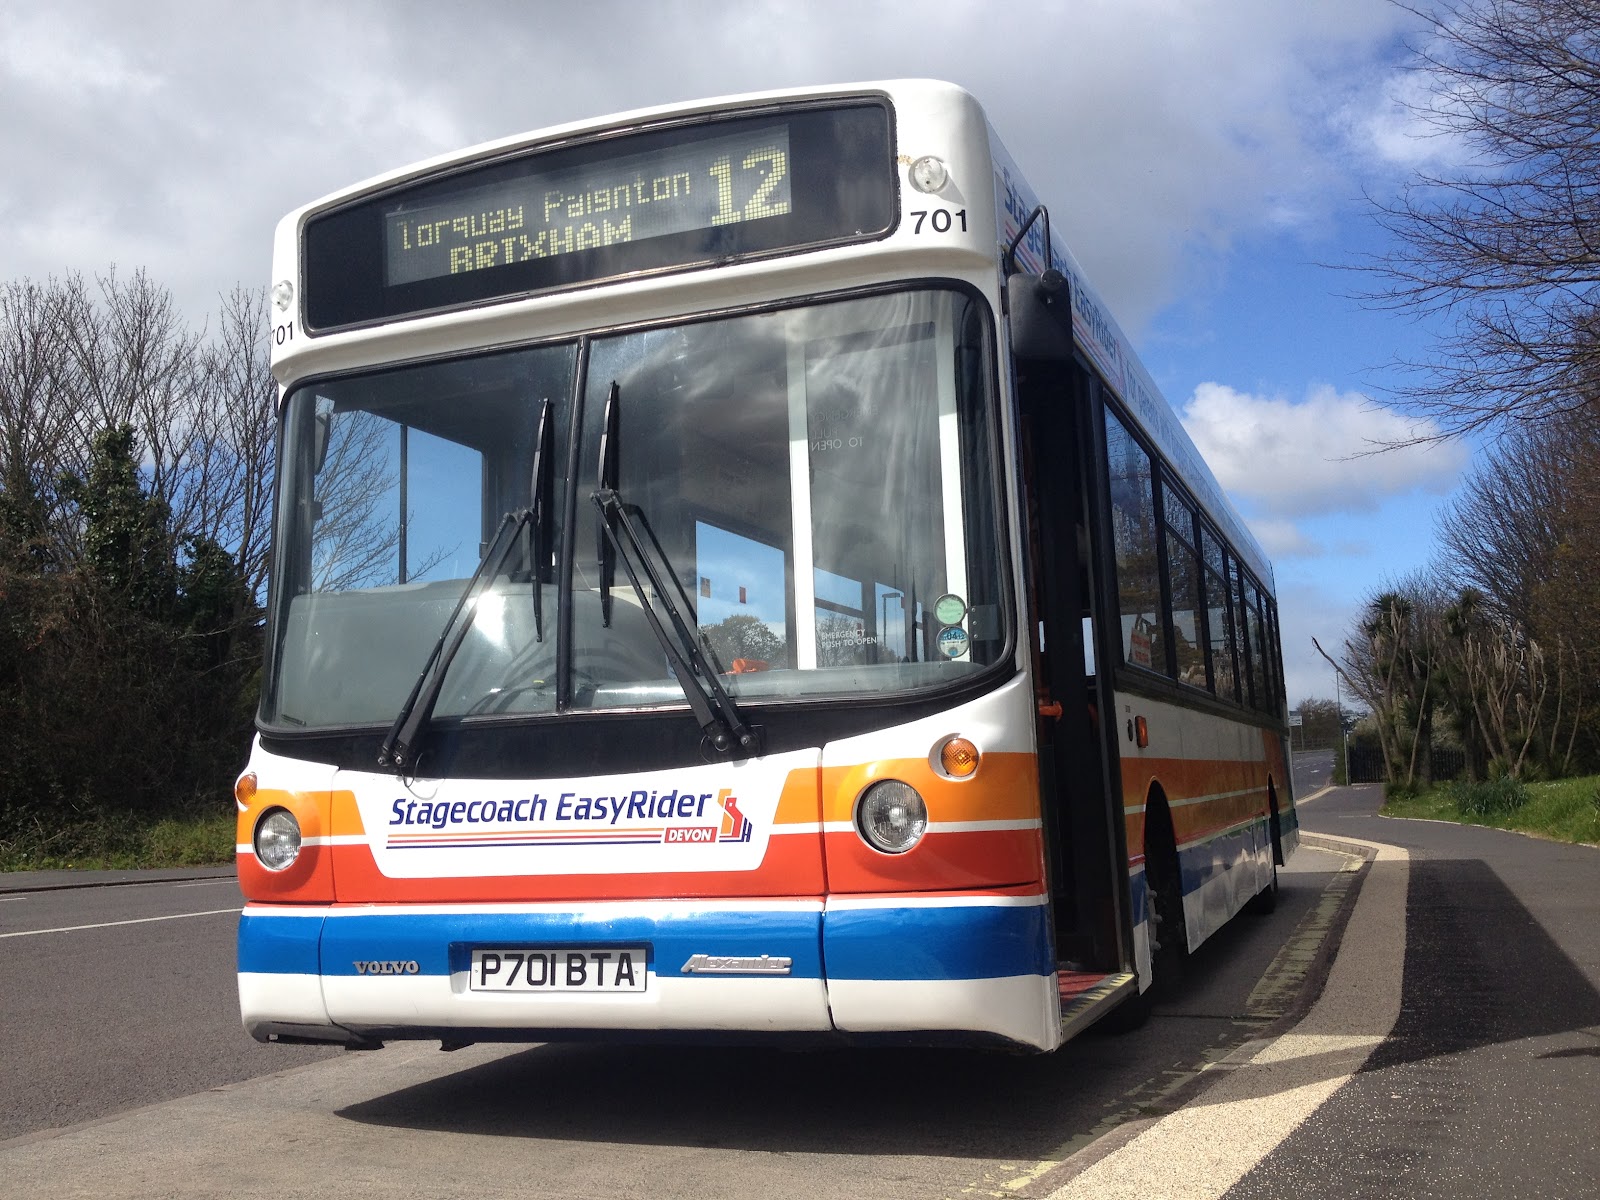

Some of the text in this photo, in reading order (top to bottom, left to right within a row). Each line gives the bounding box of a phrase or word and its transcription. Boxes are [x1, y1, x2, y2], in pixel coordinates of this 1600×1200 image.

[544, 172, 690, 222] Paignton
[708, 145, 788, 226] 12
[911, 209, 968, 235] 701
[821, 629, 866, 641] EMERGENCY
[821, 636, 877, 649] PUSH TO OPEN
[389, 789, 712, 829] Stagecoach EasyRider
[668, 829, 712, 842] DEVON
[353, 960, 419, 974] VOLVO
[480, 952, 635, 987] P701 BTA
